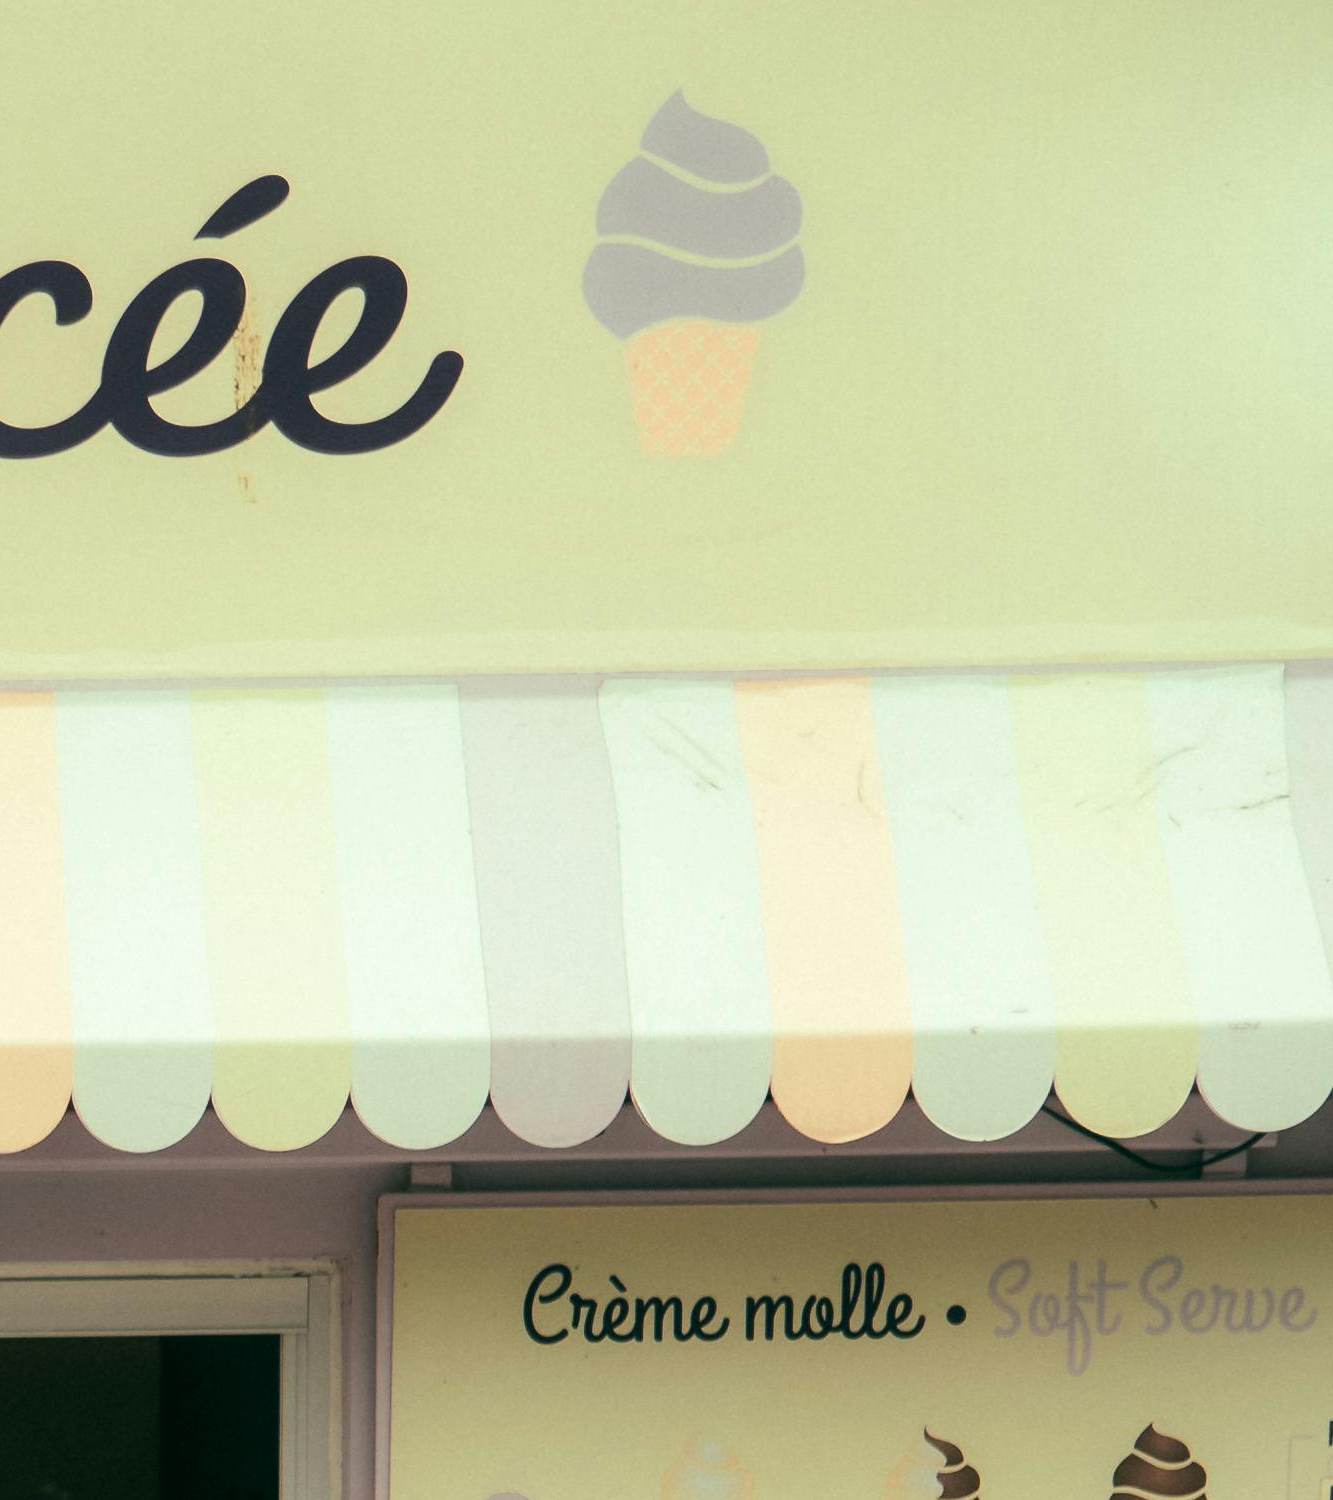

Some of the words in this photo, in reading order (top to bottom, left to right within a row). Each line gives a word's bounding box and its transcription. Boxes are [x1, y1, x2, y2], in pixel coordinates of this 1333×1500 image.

[523, 1263, 731, 1345] Crème
[745, 1261, 926, 1342] molle
[986, 1258, 1129, 1377] Soft
[1139, 1254, 1318, 1338] Serve
